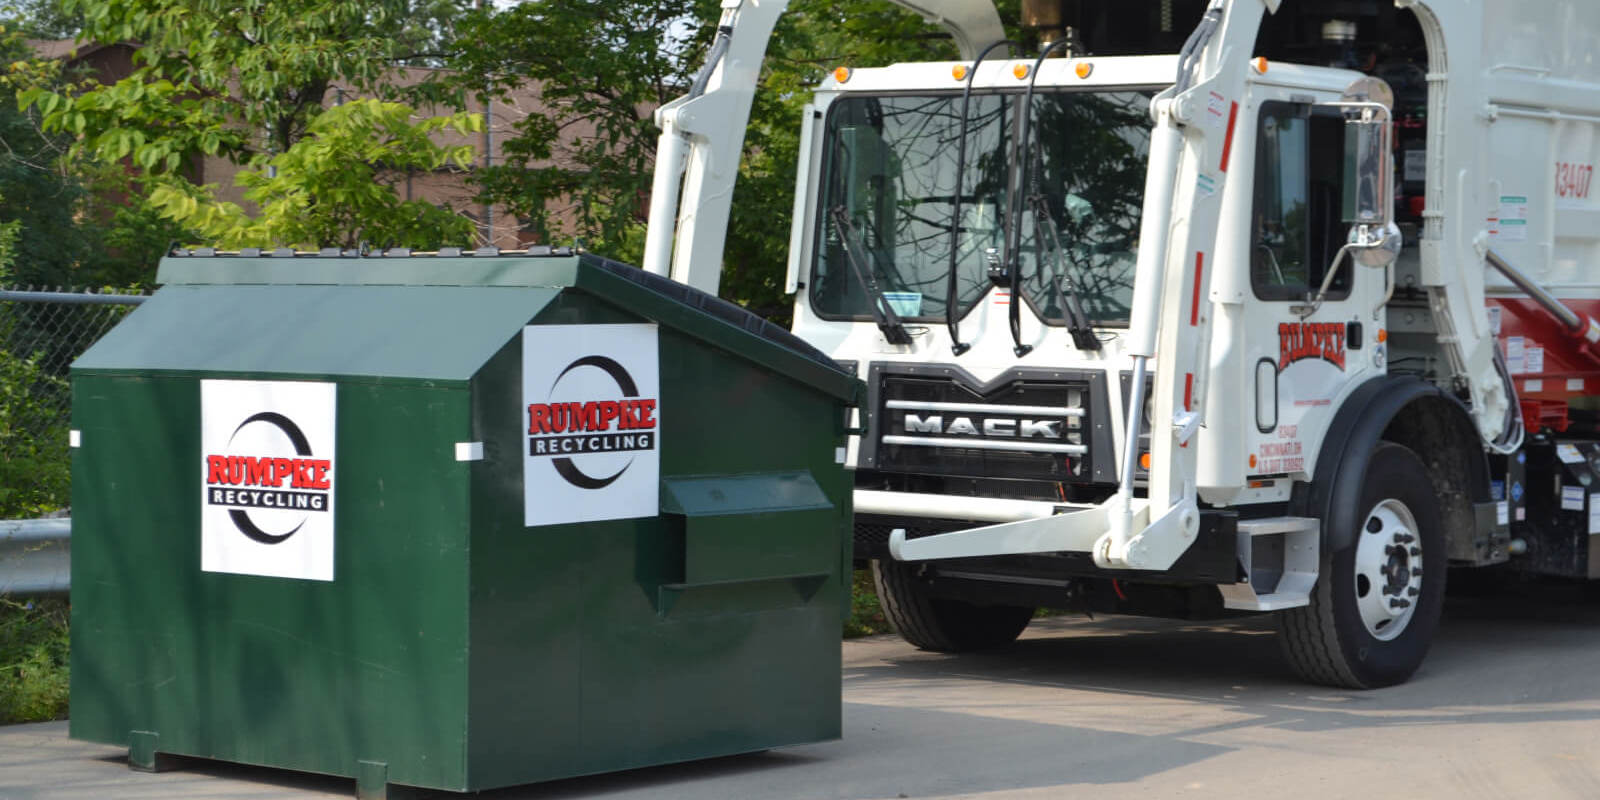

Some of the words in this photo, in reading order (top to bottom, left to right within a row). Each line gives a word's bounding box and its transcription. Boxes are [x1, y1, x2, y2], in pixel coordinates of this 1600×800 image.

[1278, 322, 1345, 372] RUMPKE
[528, 399, 656, 435] RUMPKE
[905, 414, 1063, 439] MACK
[537, 435, 649, 454] RECYCLING
[207, 455, 331, 490] RUMPKE
[213, 490, 323, 509] RECYCLING
